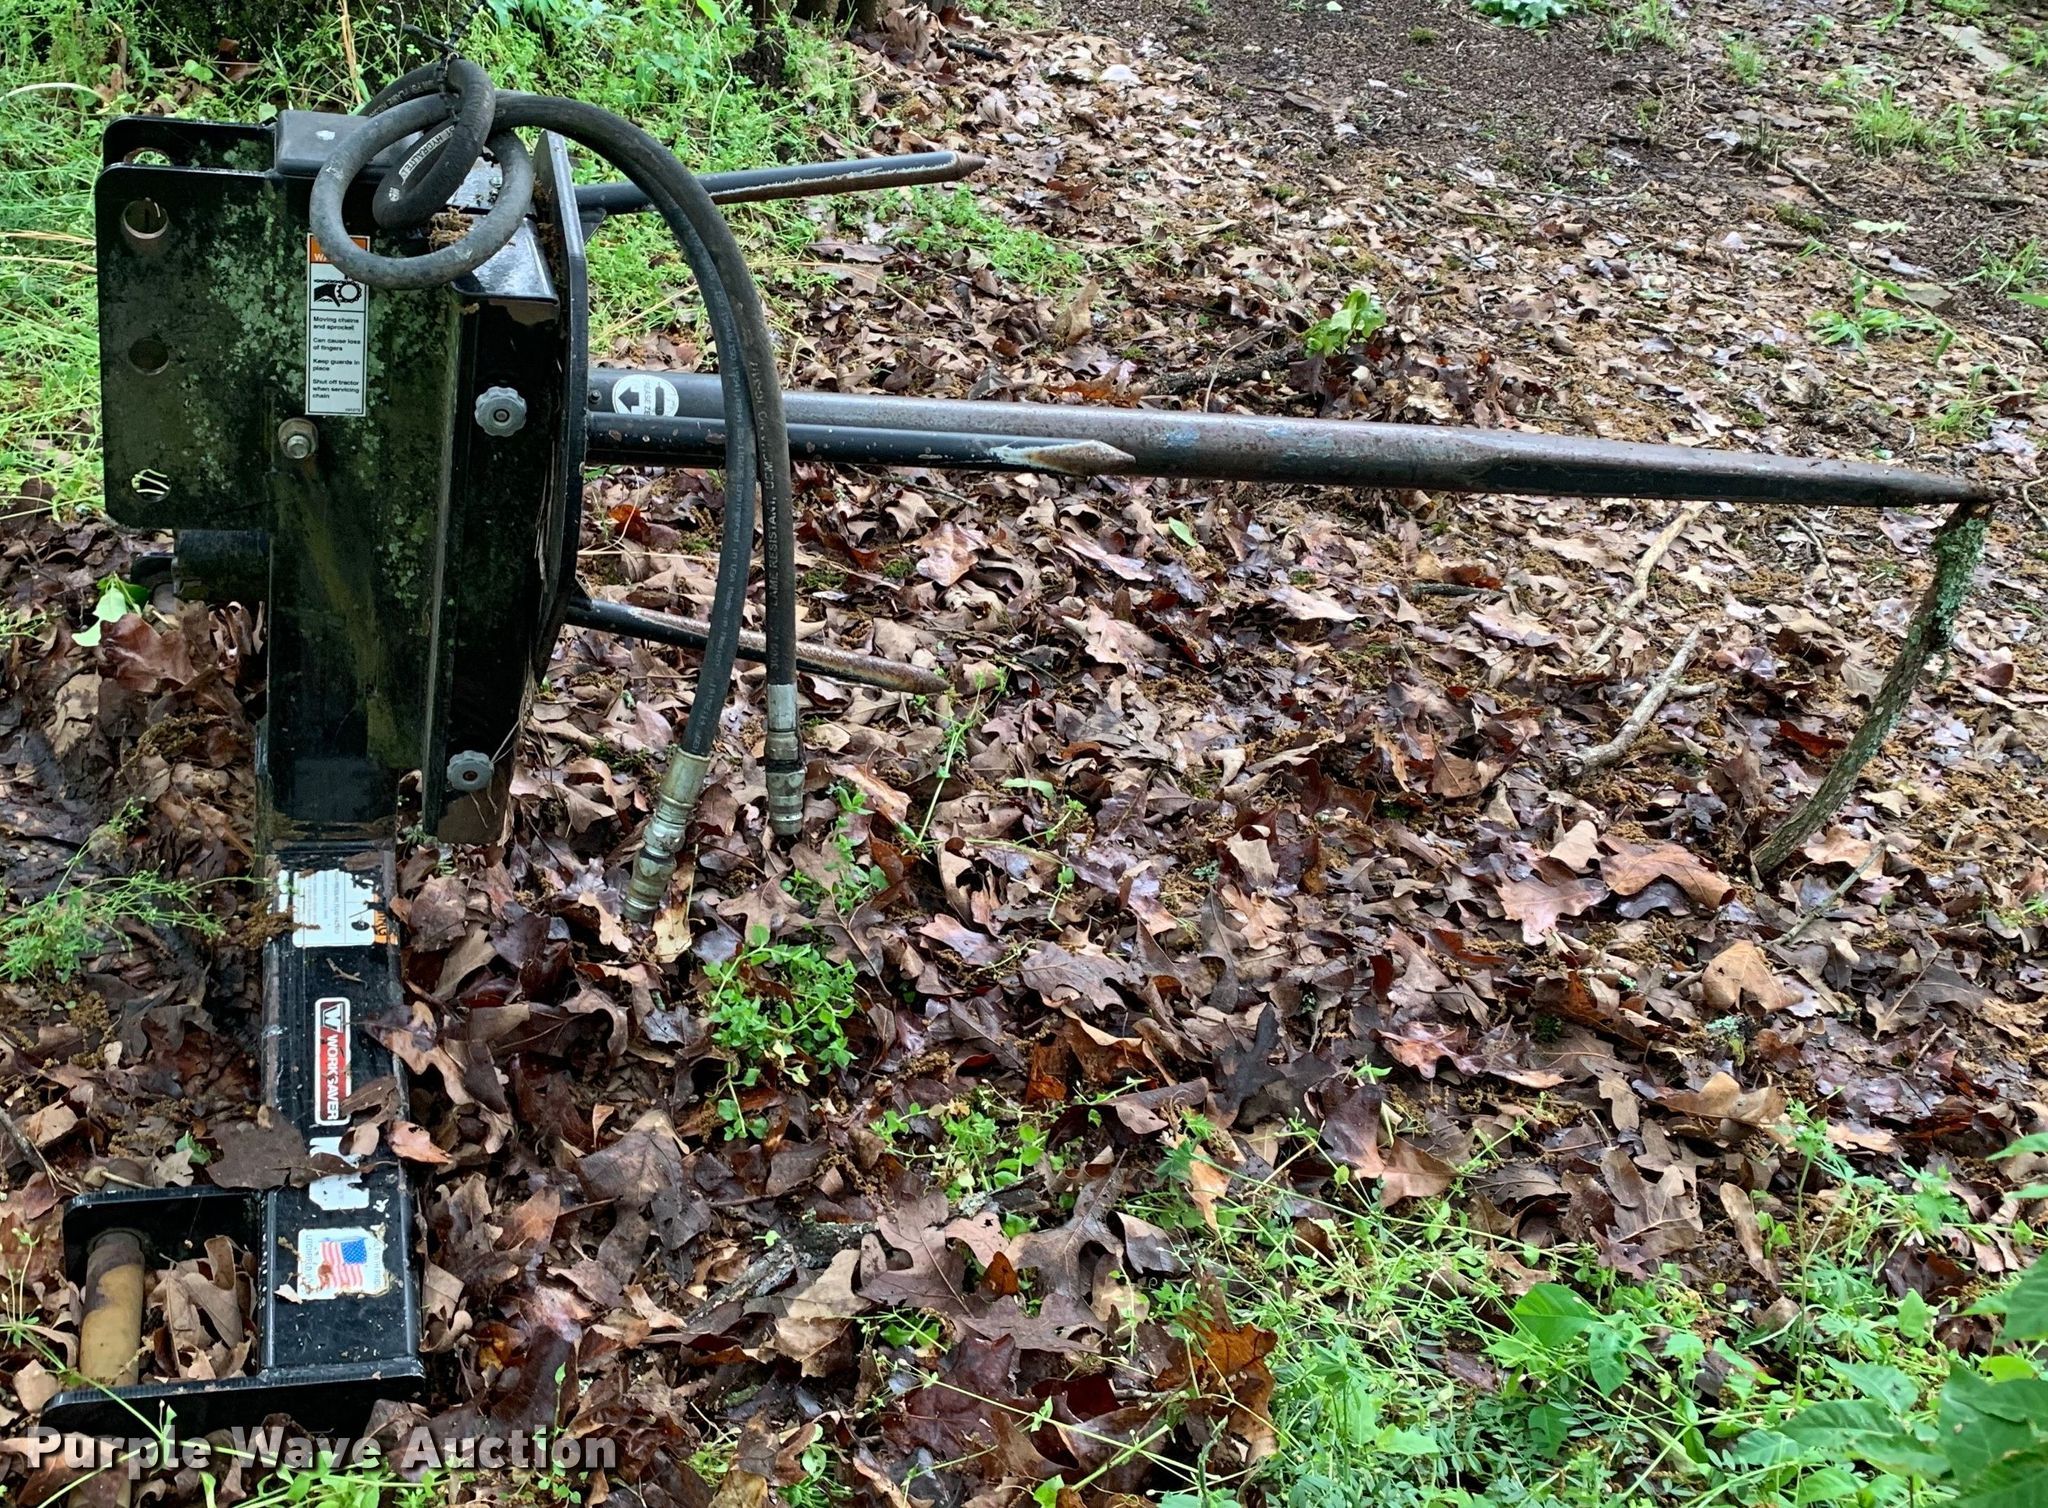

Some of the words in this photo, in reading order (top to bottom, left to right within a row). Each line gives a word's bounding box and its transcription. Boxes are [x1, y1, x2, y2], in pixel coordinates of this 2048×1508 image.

[313, 316, 337, 324] Moving
[313, 358, 329, 366] Keep
[331, 386, 360, 394] servicing
[326, 1034, 339, 1120] WORKSAVER
